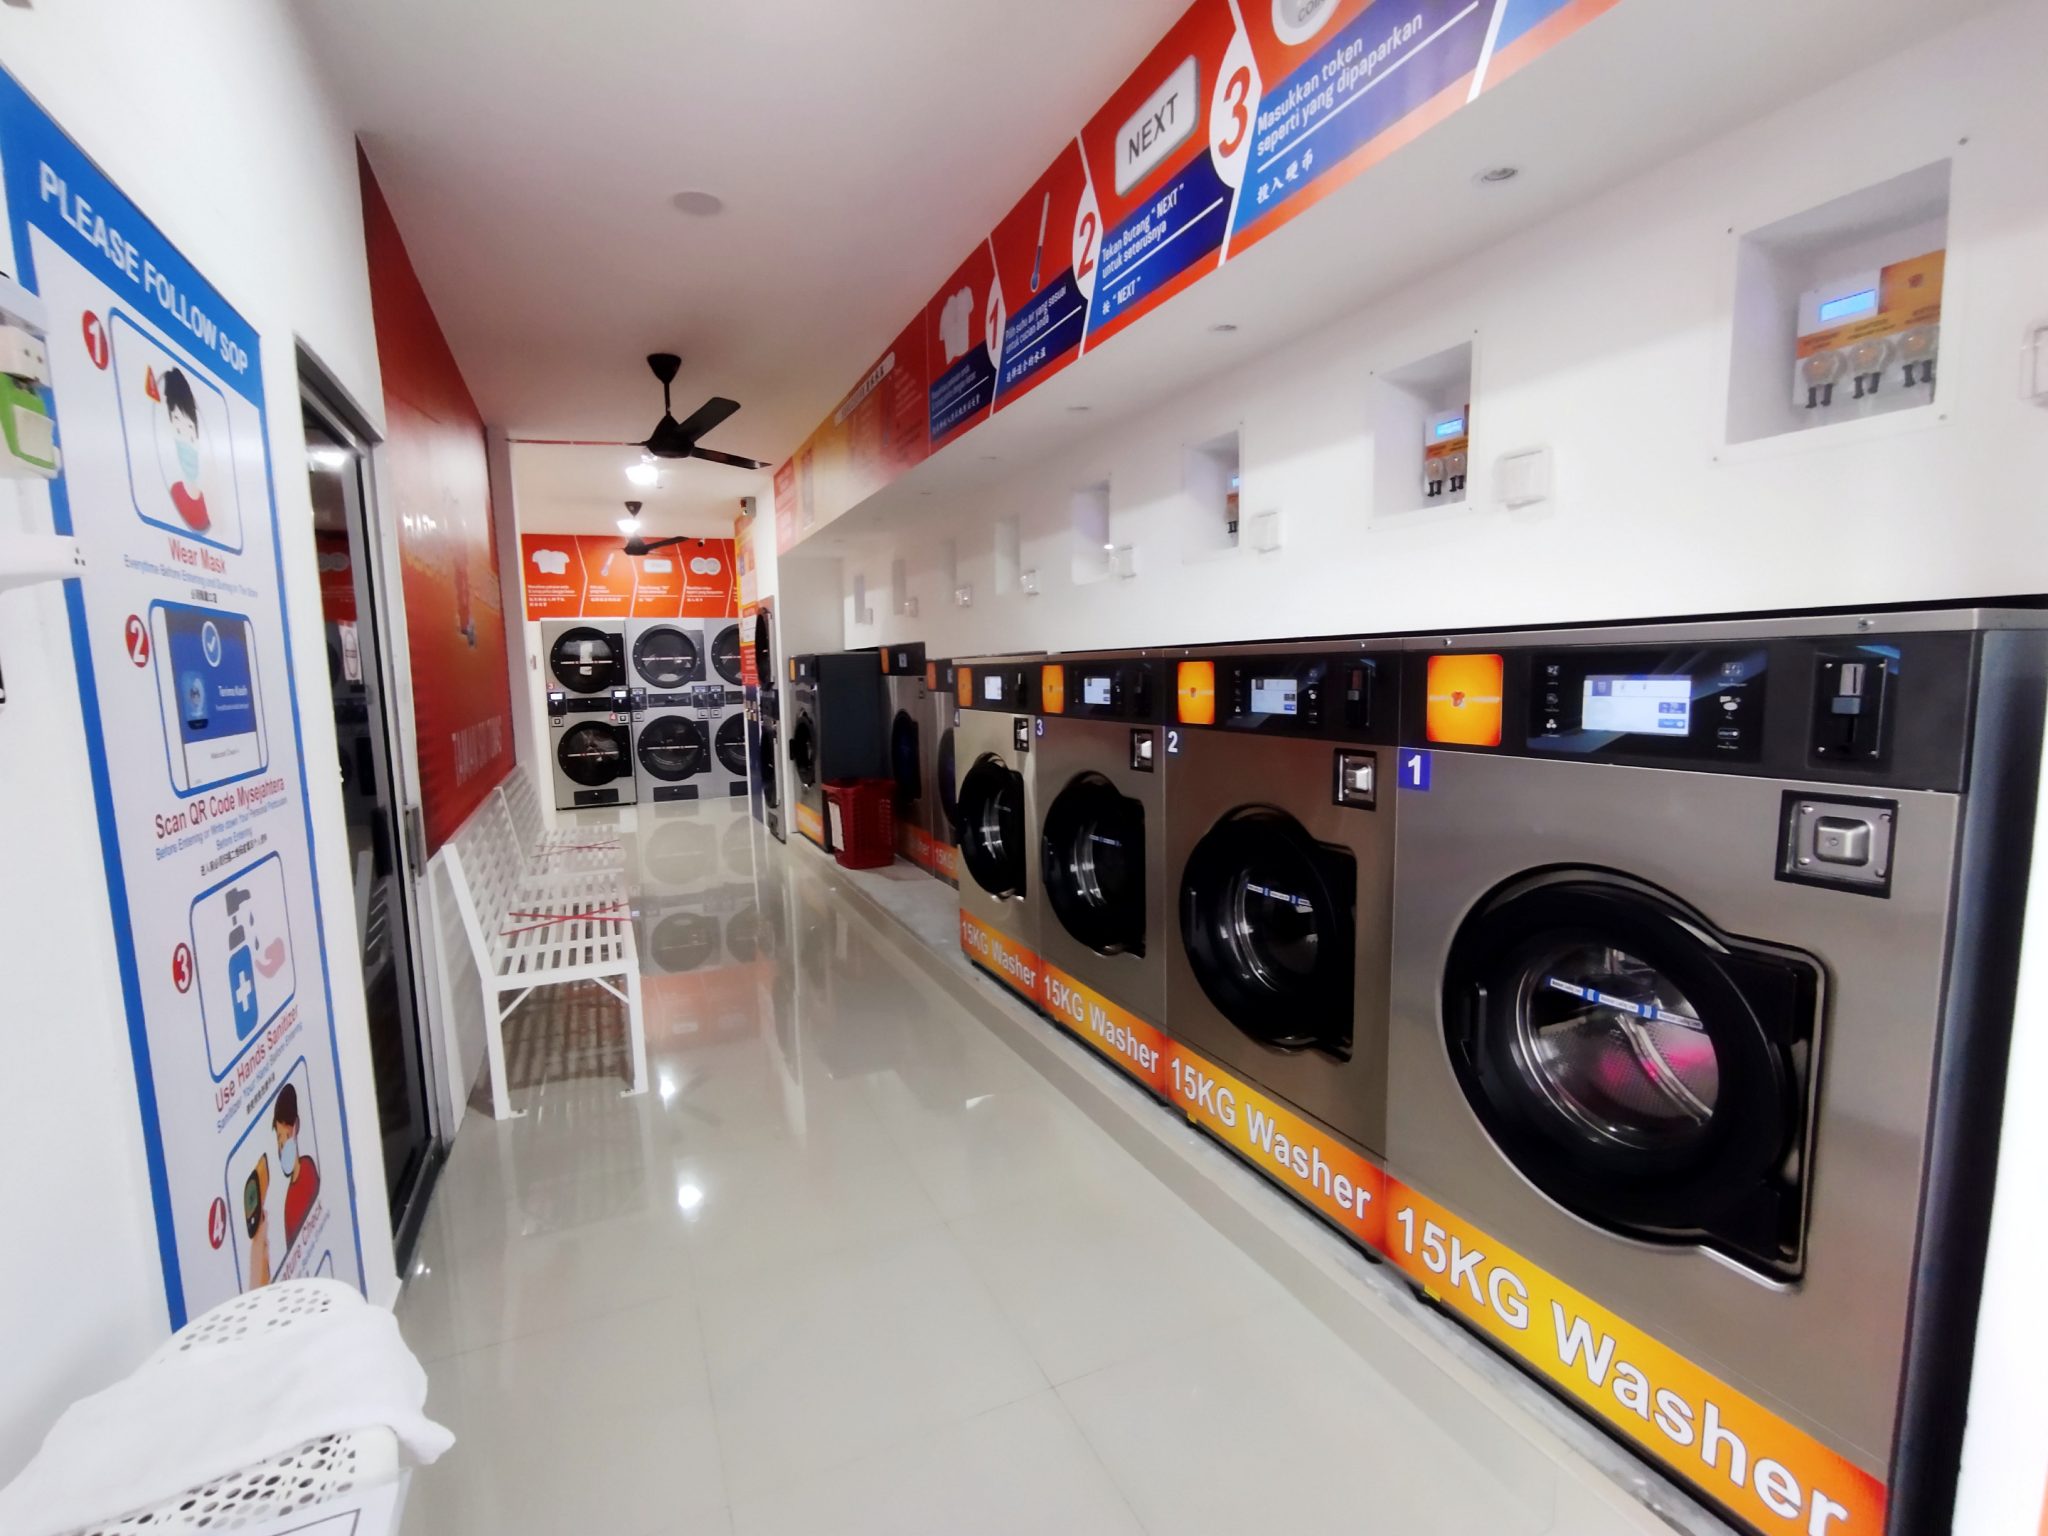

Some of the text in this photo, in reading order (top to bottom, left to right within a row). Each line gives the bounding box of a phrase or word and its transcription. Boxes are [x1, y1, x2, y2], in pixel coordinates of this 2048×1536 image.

[1218, 66, 1251, 159] 3
[1257, 13, 1422, 156] seperti yang dipaparkan
[1257, 37, 1363, 135] Masukkan token
[1128, 92, 1179, 165] NEXT
[39, 160, 249, 375] PLEASE FOLLOW SOP
[1077, 211, 1097, 281] 2
[1102, 238, 1122, 262] Tekan
[1123, 214, 1151, 247] Butang
[1102, 220, 1167, 279] untuk seterusnya
[88, 322, 101, 364] 1
[990, 297, 999, 350] 1
[166, 536, 227, 575] Wear Mask
[130, 619, 146, 662] 2
[1036, 718, 1043, 737] 3
[1168, 730, 1178, 753] 2
[1407, 754, 1422, 785] 1
[155, 813, 187, 839] Scan
[189, 799, 208, 826] QR
[209, 791, 235, 818] Code
[178, 949, 190, 989] 3
[961, 919, 1037, 989] 15KG Washer
[1043, 973, 1159, 1074] 15KG Washer
[215, 1080, 235, 1112] Use
[236, 1043, 266, 1087] Hands
[266, 1004, 298, 1050] Sanitizer
[1171, 1057, 1371, 1219] 15KG Washer
[213, 1201, 224, 1243] 4
[1396, 1206, 1849, 1536] 15KG Washer
